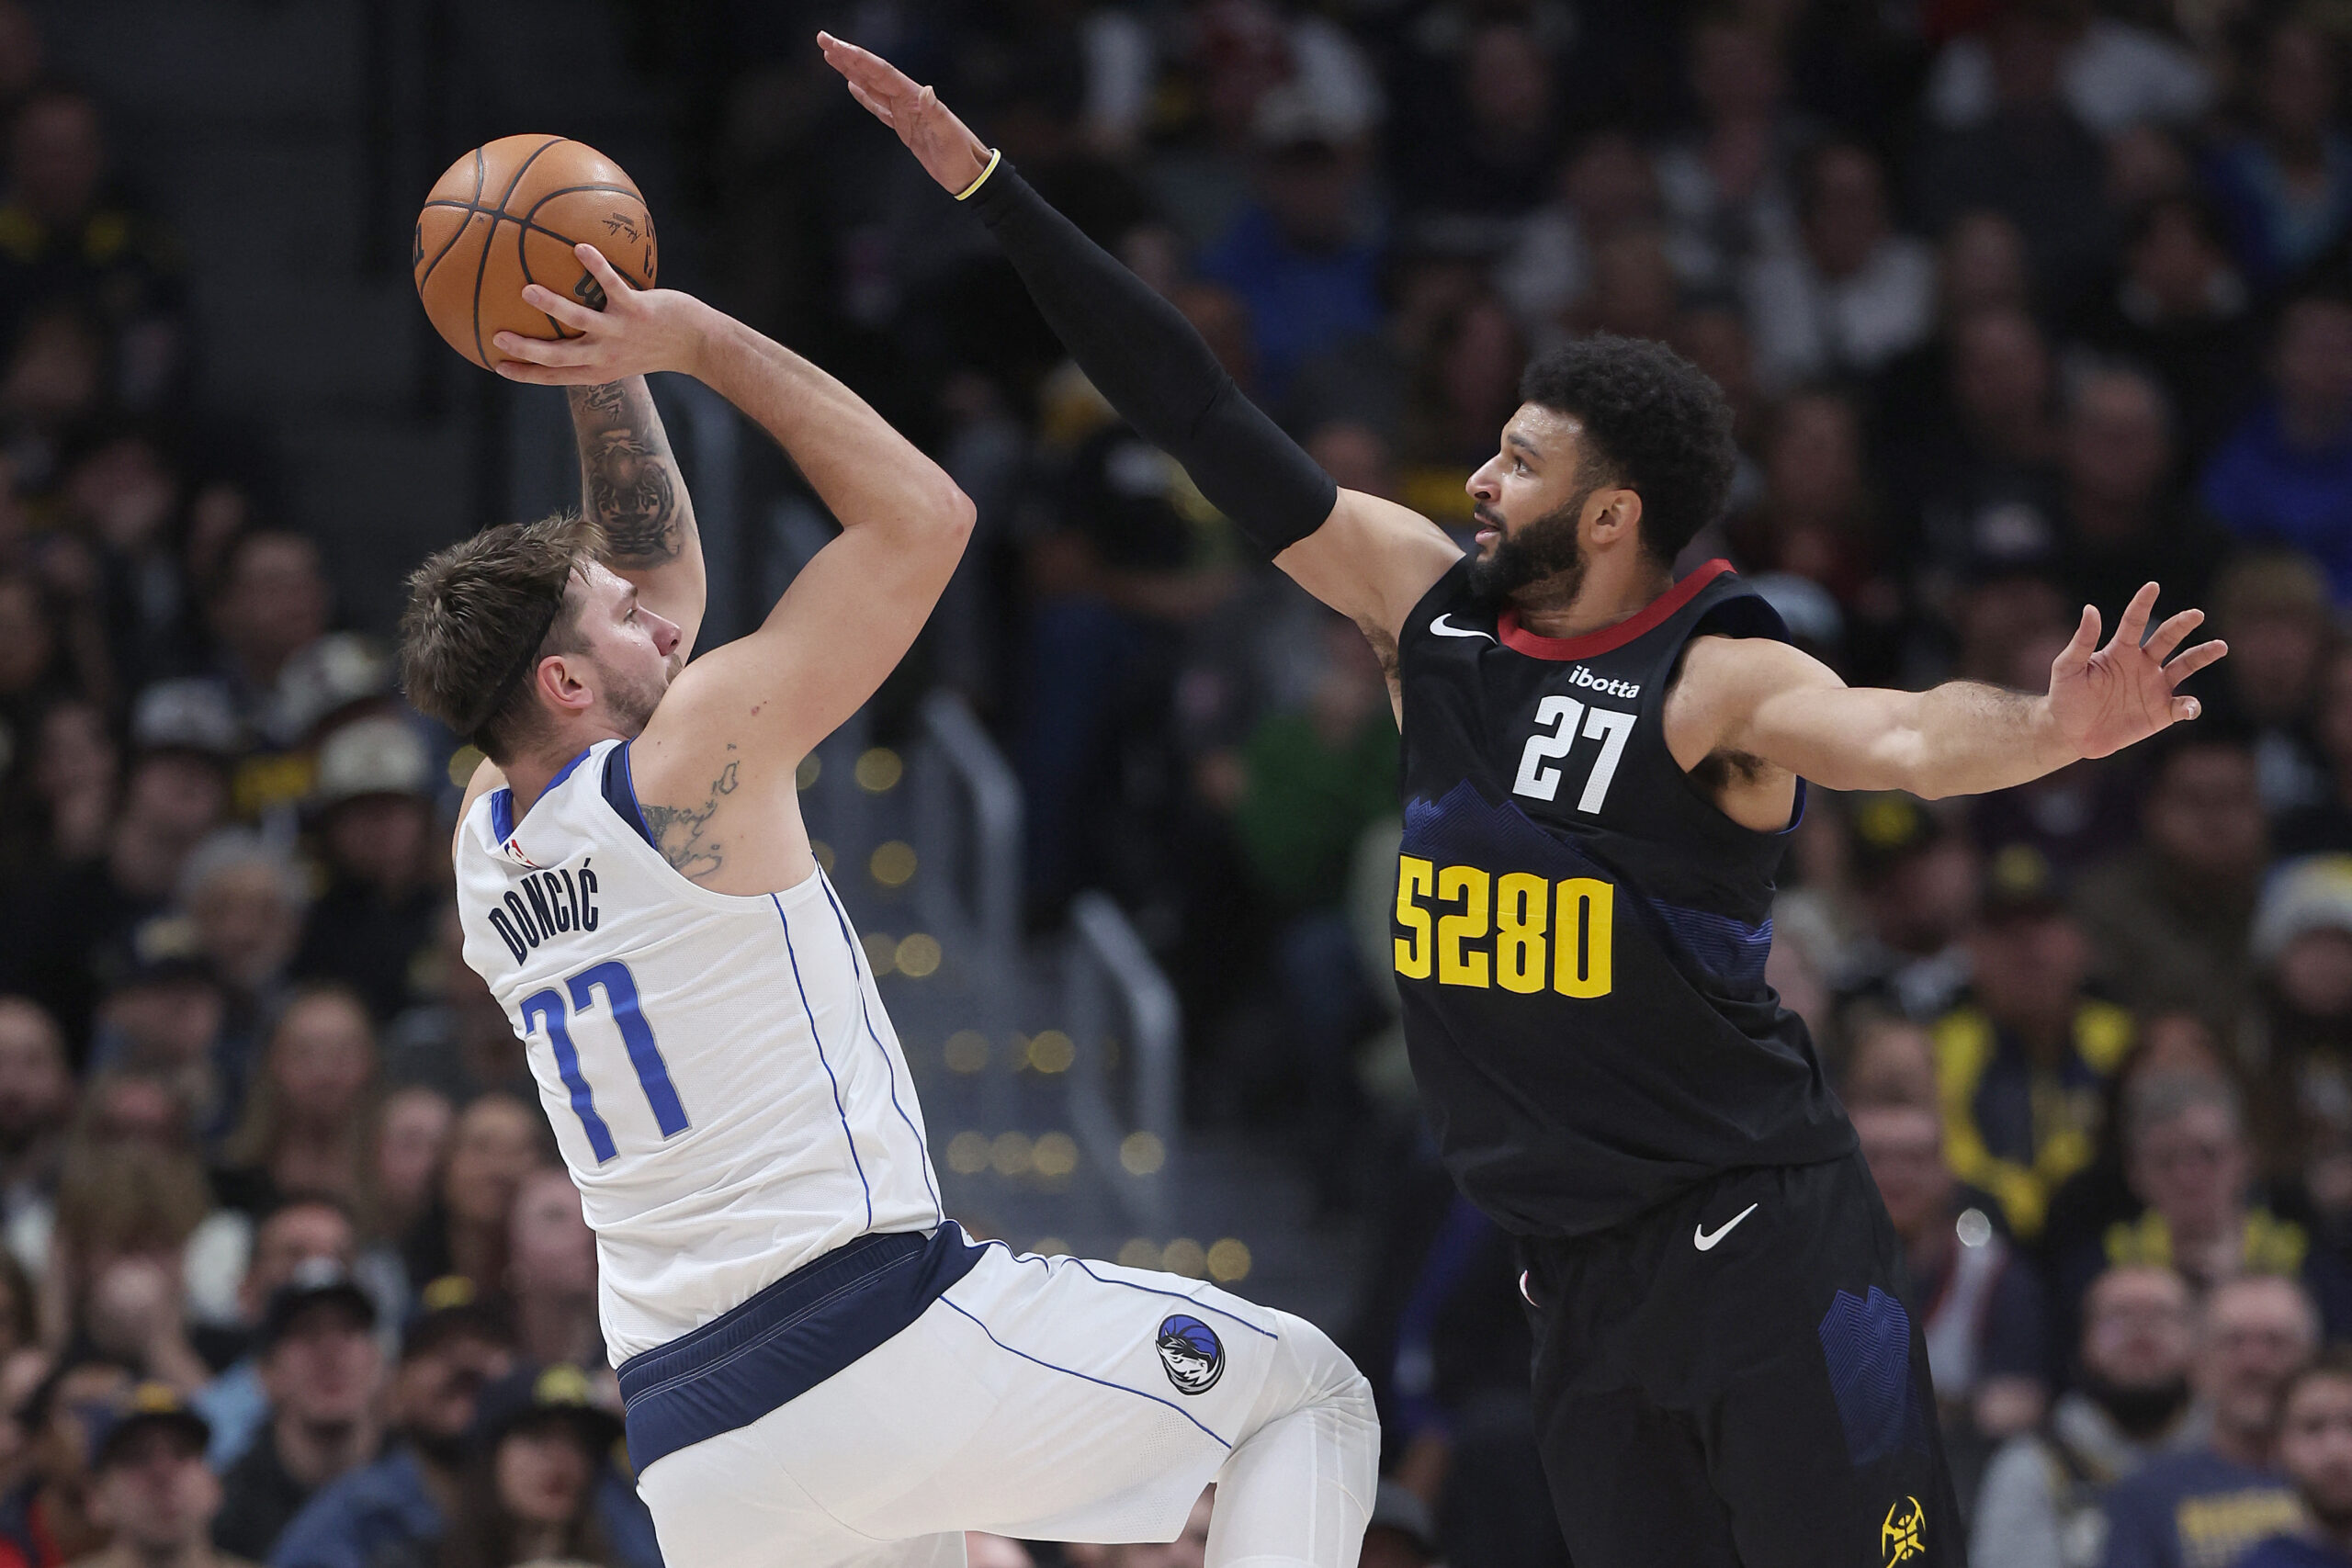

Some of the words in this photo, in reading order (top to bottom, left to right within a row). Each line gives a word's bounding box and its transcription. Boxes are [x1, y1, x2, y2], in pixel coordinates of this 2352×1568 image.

[1568, 664, 1640, 699] ibotta
[1512, 694, 1638, 815] 27
[488, 858, 599, 966] DONCIĆ
[1394, 854, 1614, 999] 5280
[519, 958, 693, 1168] 77
